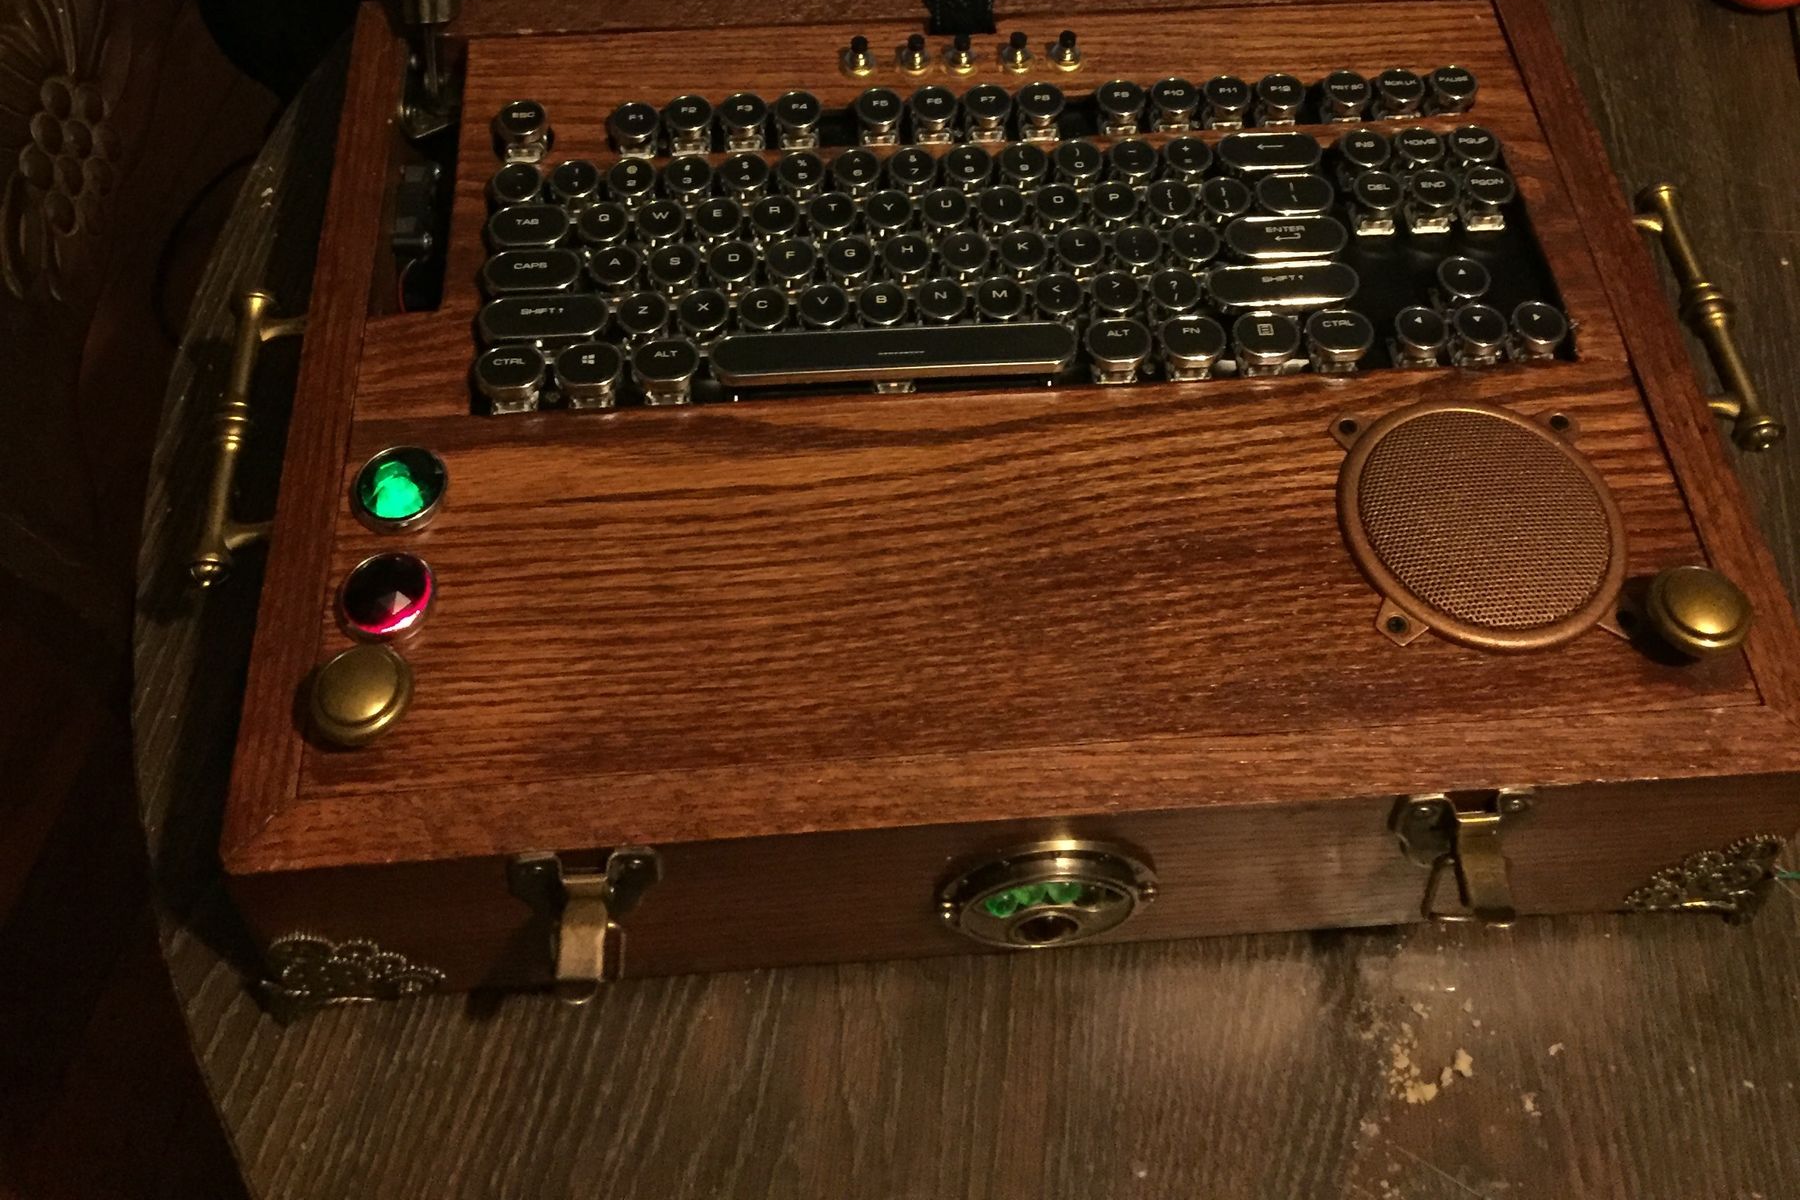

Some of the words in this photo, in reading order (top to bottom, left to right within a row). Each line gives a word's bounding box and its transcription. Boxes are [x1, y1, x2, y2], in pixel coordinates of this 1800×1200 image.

[1163, 89, 1184, 97] F10
[1403, 137, 1437, 146] HOME
[1458, 136, 1489, 145] PGUP
[1019, 164, 1030, 172] 9
[798, 172, 808, 180] 5
[1420, 180, 1447, 189] END
[1470, 177, 1504, 187] PGDN
[1367, 183, 1391, 191] DEL
[1052, 195, 1064, 204] O
[1108, 193, 1120, 201] P
[827, 203, 838, 211] T
[882, 203, 894, 211] Y
[940, 200, 952, 208] U
[712, 209, 723, 217] E
[768, 206, 781, 214] R
[598, 213, 610, 222] Q
[652, 211, 670, 220] W
[1265, 225, 1306, 233] ENTER
[959, 243, 970, 252] J
[1017, 241, 1029, 250] K
[1075, 239, 1085, 247] L
[844, 249, 856, 257] G
[901, 245, 914, 254] H
[727, 253, 740, 262] D
[785, 251, 796, 259] F
[513, 261, 548, 270] CAPS
[608, 257, 621, 266] A
[669, 257, 681, 266] S
[1261, 274, 1295, 283] SHIFT
[1169, 280, 1178, 290] ?
[934, 291, 947, 300] N
[992, 289, 1009, 298] M
[816, 296, 829, 305] V
[875, 295, 888, 304] B
[697, 302, 710, 312] X
[756, 300, 769, 309] C
[520, 307, 555, 316] SHIFT
[637, 305, 649, 314] Z
[1322, 319, 1355, 328] CTRL
[1106, 328, 1130, 337] ALT
[654, 350, 679, 358] ALT
[492, 358, 526, 366] CTRL
